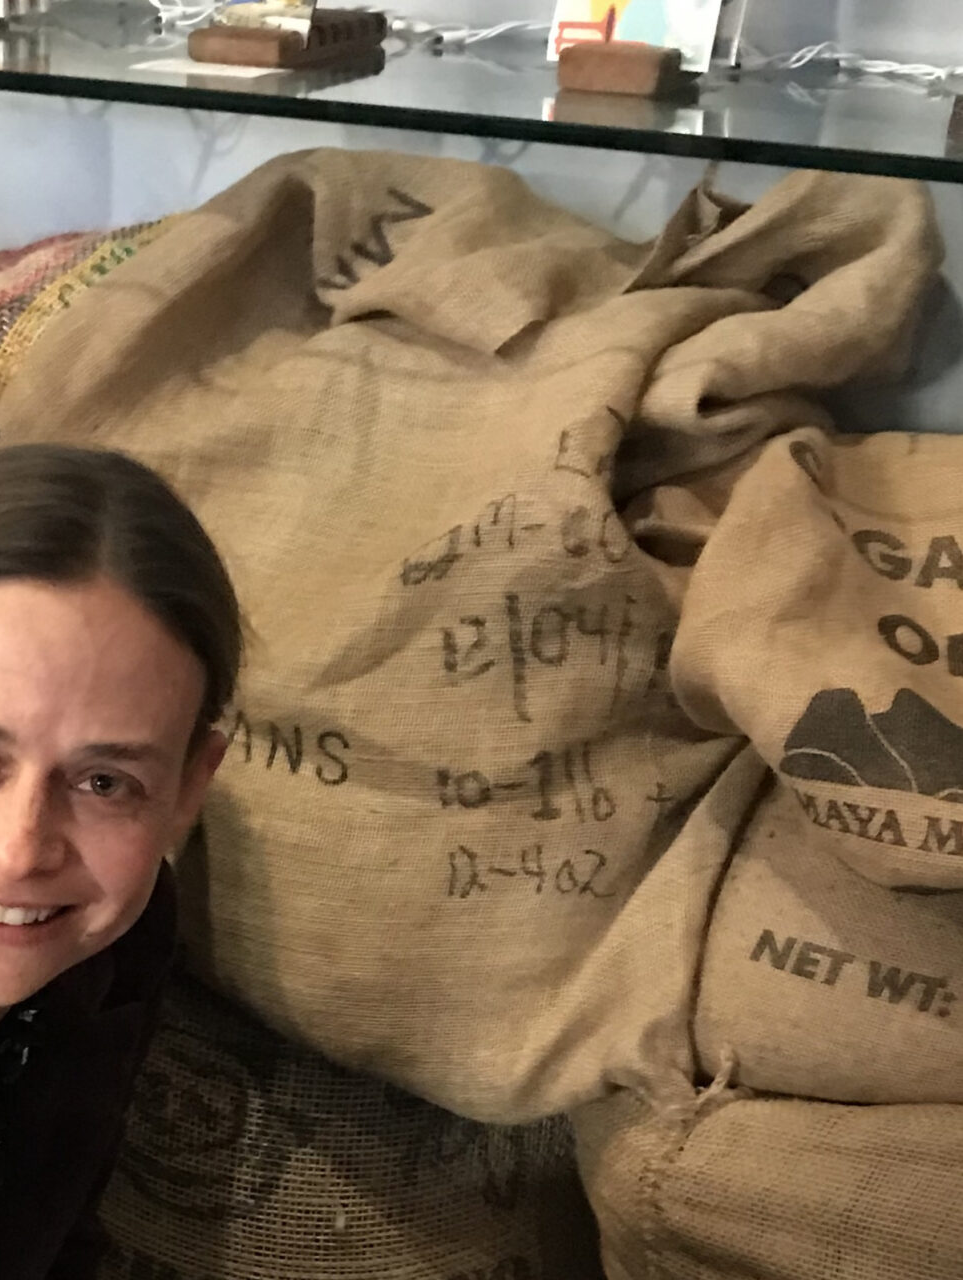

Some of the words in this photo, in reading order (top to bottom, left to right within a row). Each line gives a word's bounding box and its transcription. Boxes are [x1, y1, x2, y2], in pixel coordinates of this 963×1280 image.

[877, 614, 963, 677] O
[749, 928, 857, 986] NET
[866, 960, 958, 1018] WT:
